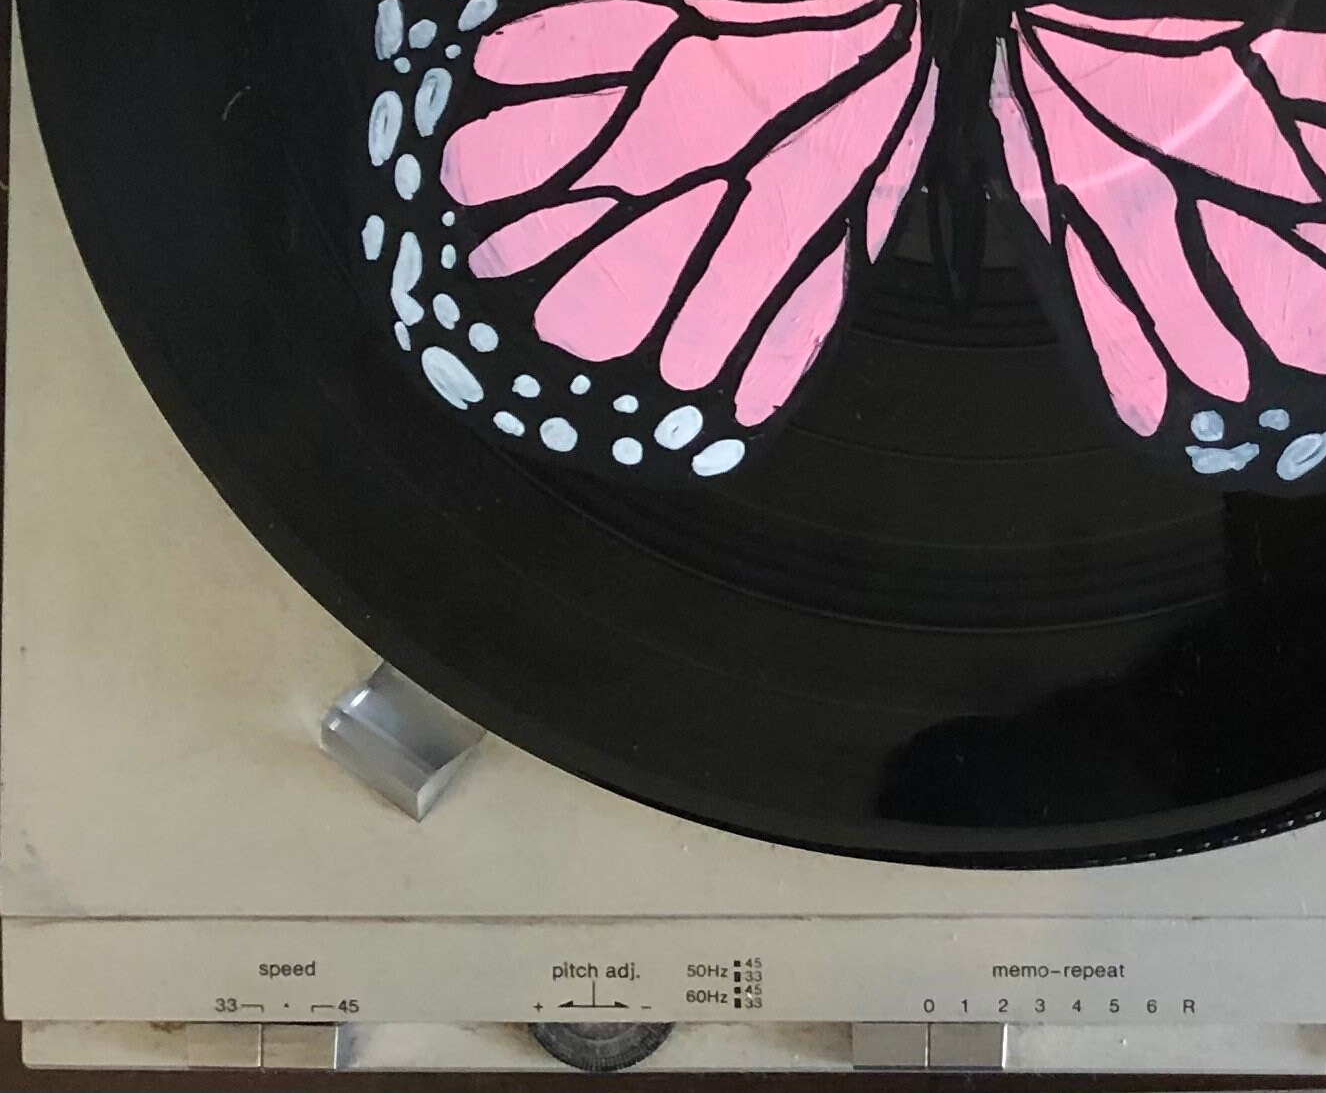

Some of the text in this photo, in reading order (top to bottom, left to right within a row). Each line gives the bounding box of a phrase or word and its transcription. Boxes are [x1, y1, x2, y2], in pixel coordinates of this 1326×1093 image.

[259, 960, 316, 979] speed
[552, 961, 641, 981] pitch adj.
[687, 958, 762, 978] 50Hz 45
[744, 970, 762, 982] 33
[992, 963, 1125, 981] memo-repeat
[686, 985, 762, 1003] 60Hz 45
[744, 997, 763, 1009] 33
[215, 998, 360, 1013] 33 45
[923, 998, 1196, 1013] 0 1 2 3 4 5 6 R
